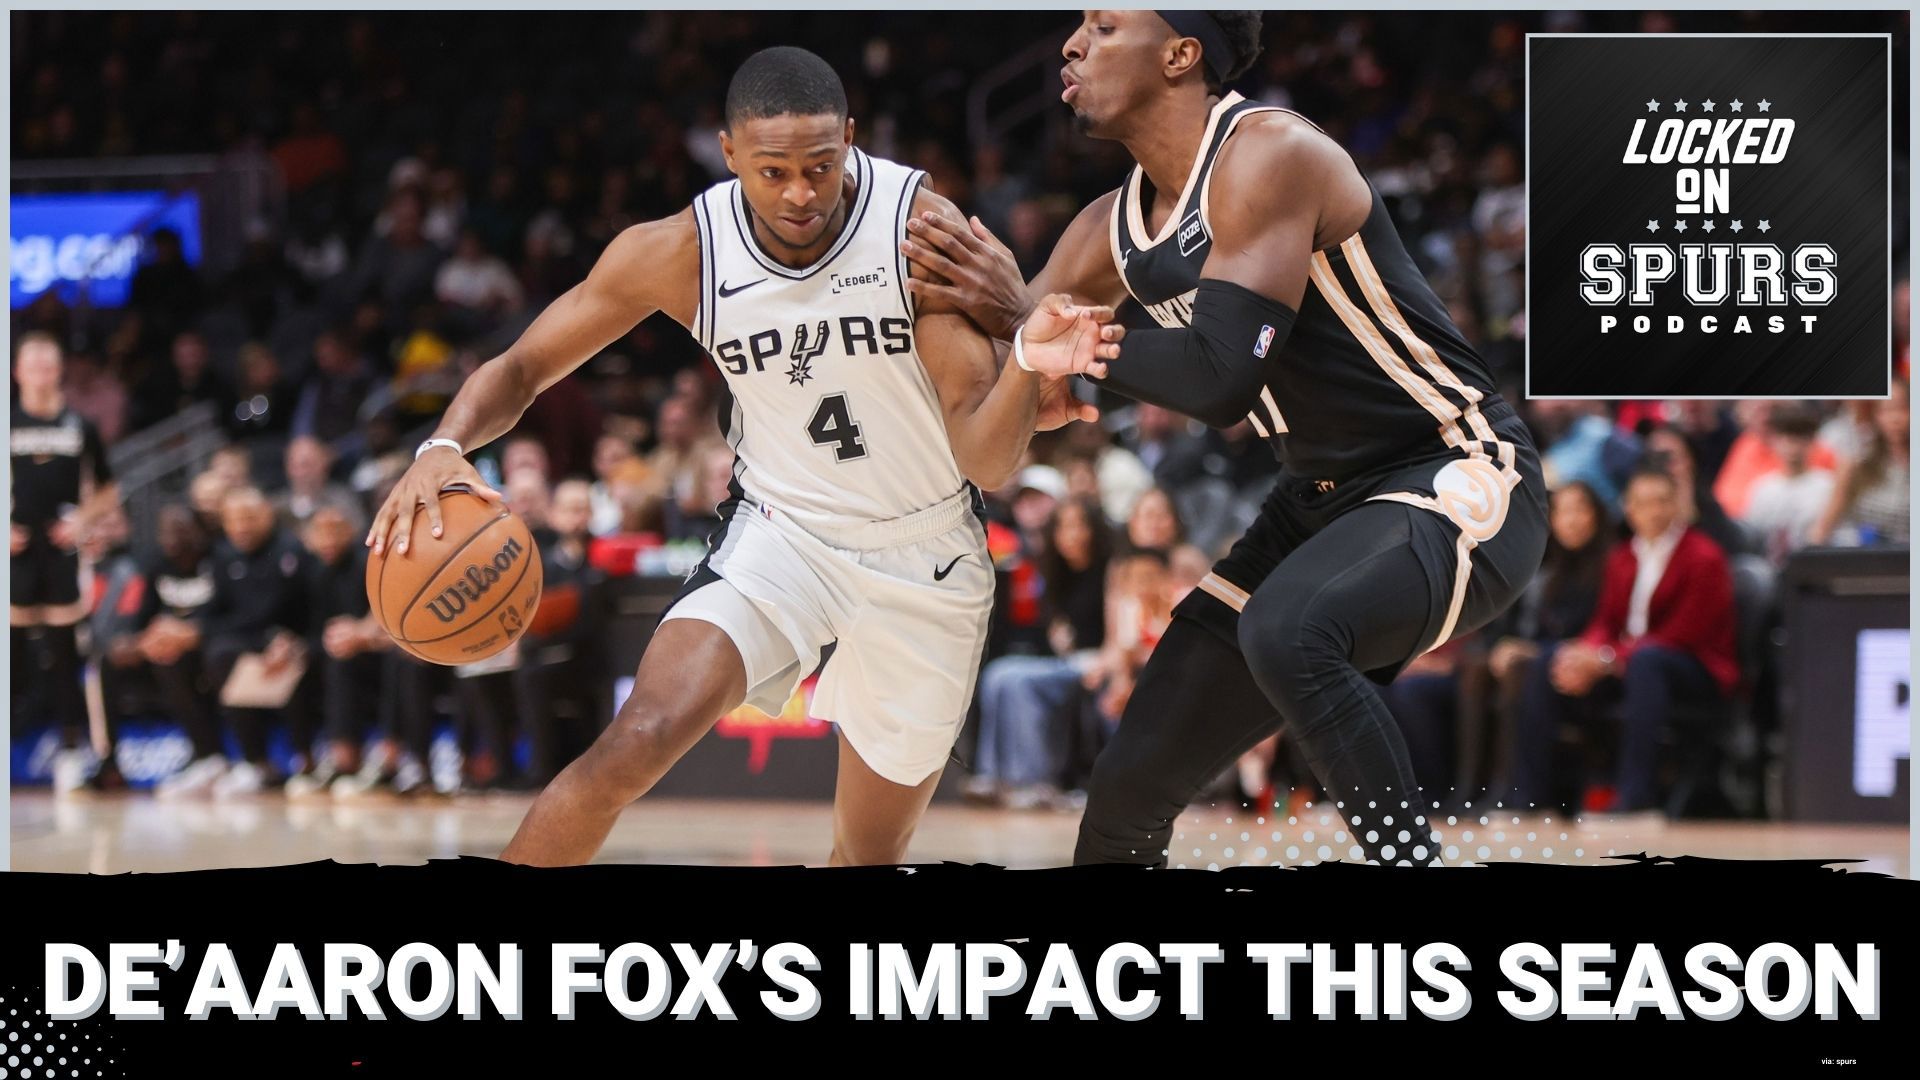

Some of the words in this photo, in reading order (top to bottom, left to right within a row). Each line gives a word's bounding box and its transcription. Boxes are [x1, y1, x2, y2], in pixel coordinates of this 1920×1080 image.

[838, 273, 880, 289] LEDGER
[716, 316, 912, 388] SPURS
[804, 390, 871, 465] 4
[425, 537, 523, 623] Wilson
